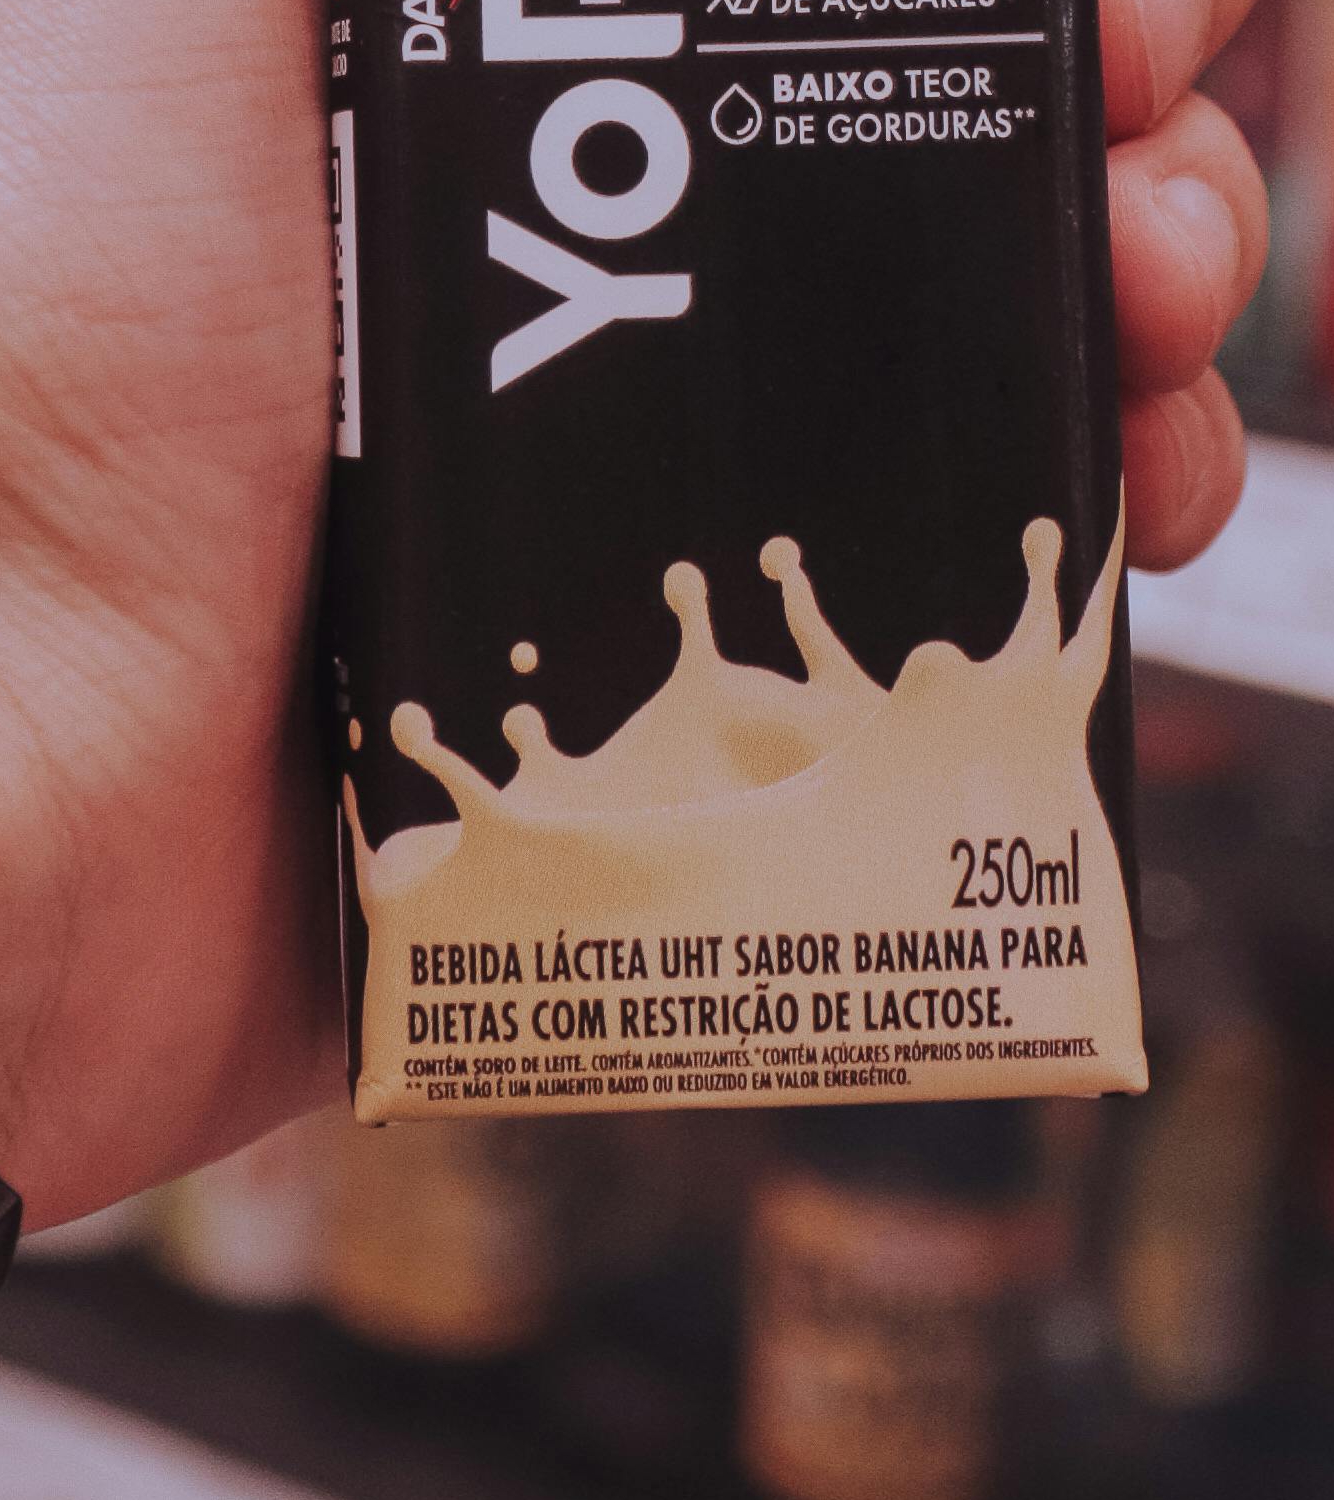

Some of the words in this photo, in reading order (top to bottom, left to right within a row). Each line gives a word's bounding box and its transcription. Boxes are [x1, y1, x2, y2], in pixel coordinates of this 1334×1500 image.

[773, 69, 894, 103] BAIXO
[904, 66, 993, 99] TEOR
[775, 114, 816, 145] DE
[950, 828, 1081, 909] 250ml
[410, 943, 523, 986] BEBIDA
[534, 930, 649, 982] LÁCTEA
[659, 936, 723, 979] UHT
[734, 931, 842, 977] SABOR
[853, 929, 989, 973] BANANA
[1000, 925, 1089, 969] PARA
[407, 1001, 519, 1045] DIETAS
[532, 999, 608, 1041] COM
[620, 983, 800, 1046] RESTRIÇÃO
[811, 992, 851, 1033] DE
[863, 987, 1014, 1032] LACTOSE.
[403, 1054, 468, 1077] CONTÉM
[473, 1057, 517, 1075] SORO
[521, 1056, 539, 1073] DE
[544, 1055, 586, 1073] LEITE.
[591, 1050, 643, 1071] CONTÉM
[646, 1050, 753, 1069] AROMATIZANTES.
[821, 1042, 890, 1068] AÇÚCARES
[894, 1040, 962, 1063] PRÓPRIOS
[966, 1041, 995, 1060] DOS
[998, 1037, 1099, 1060] INGREDIENTES.
[427, 1081, 458, 1100] ESTE
[463, 1076, 493, 1099] NÃO
[496, 1076, 504, 1098] É
[508, 1080, 532, 1097] UM
[535, 1077, 604, 1096] ALIMENTO
[607, 1076, 649, 1095] BAIXO
[652, 1075, 673, 1093] OU
[677, 1072, 748, 1092] REDUZIDO
[752, 1071, 772, 1090] EM
[775, 1069, 819, 1089] VALOR
[824, 1065, 912, 1087] ENERGÉTICO.
